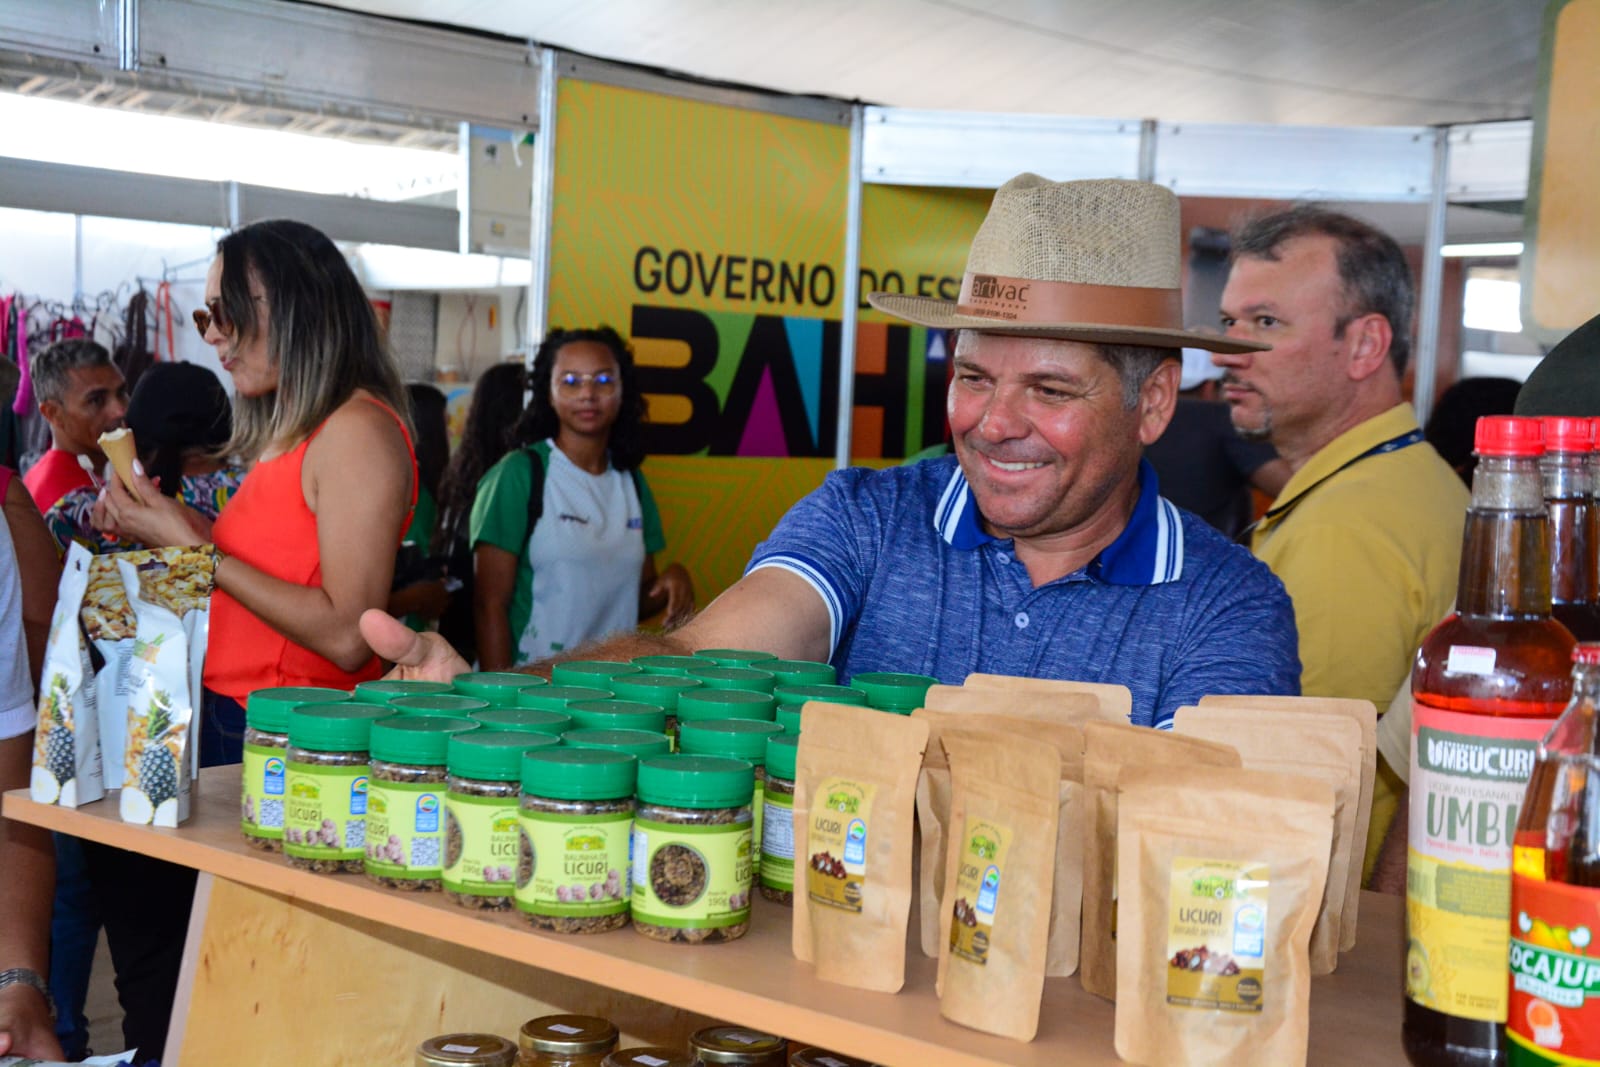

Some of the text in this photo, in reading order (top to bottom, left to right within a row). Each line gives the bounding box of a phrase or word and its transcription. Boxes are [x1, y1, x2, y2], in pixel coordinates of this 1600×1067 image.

[633, 246, 836, 308] GOVERNO
[917, 272, 963, 302] ES
[630, 304, 953, 459] BAHI
[563, 861, 609, 875] LICURI
[1178, 906, 1223, 927] LICURI
[1510, 944, 1600, 988] OCAJUP
